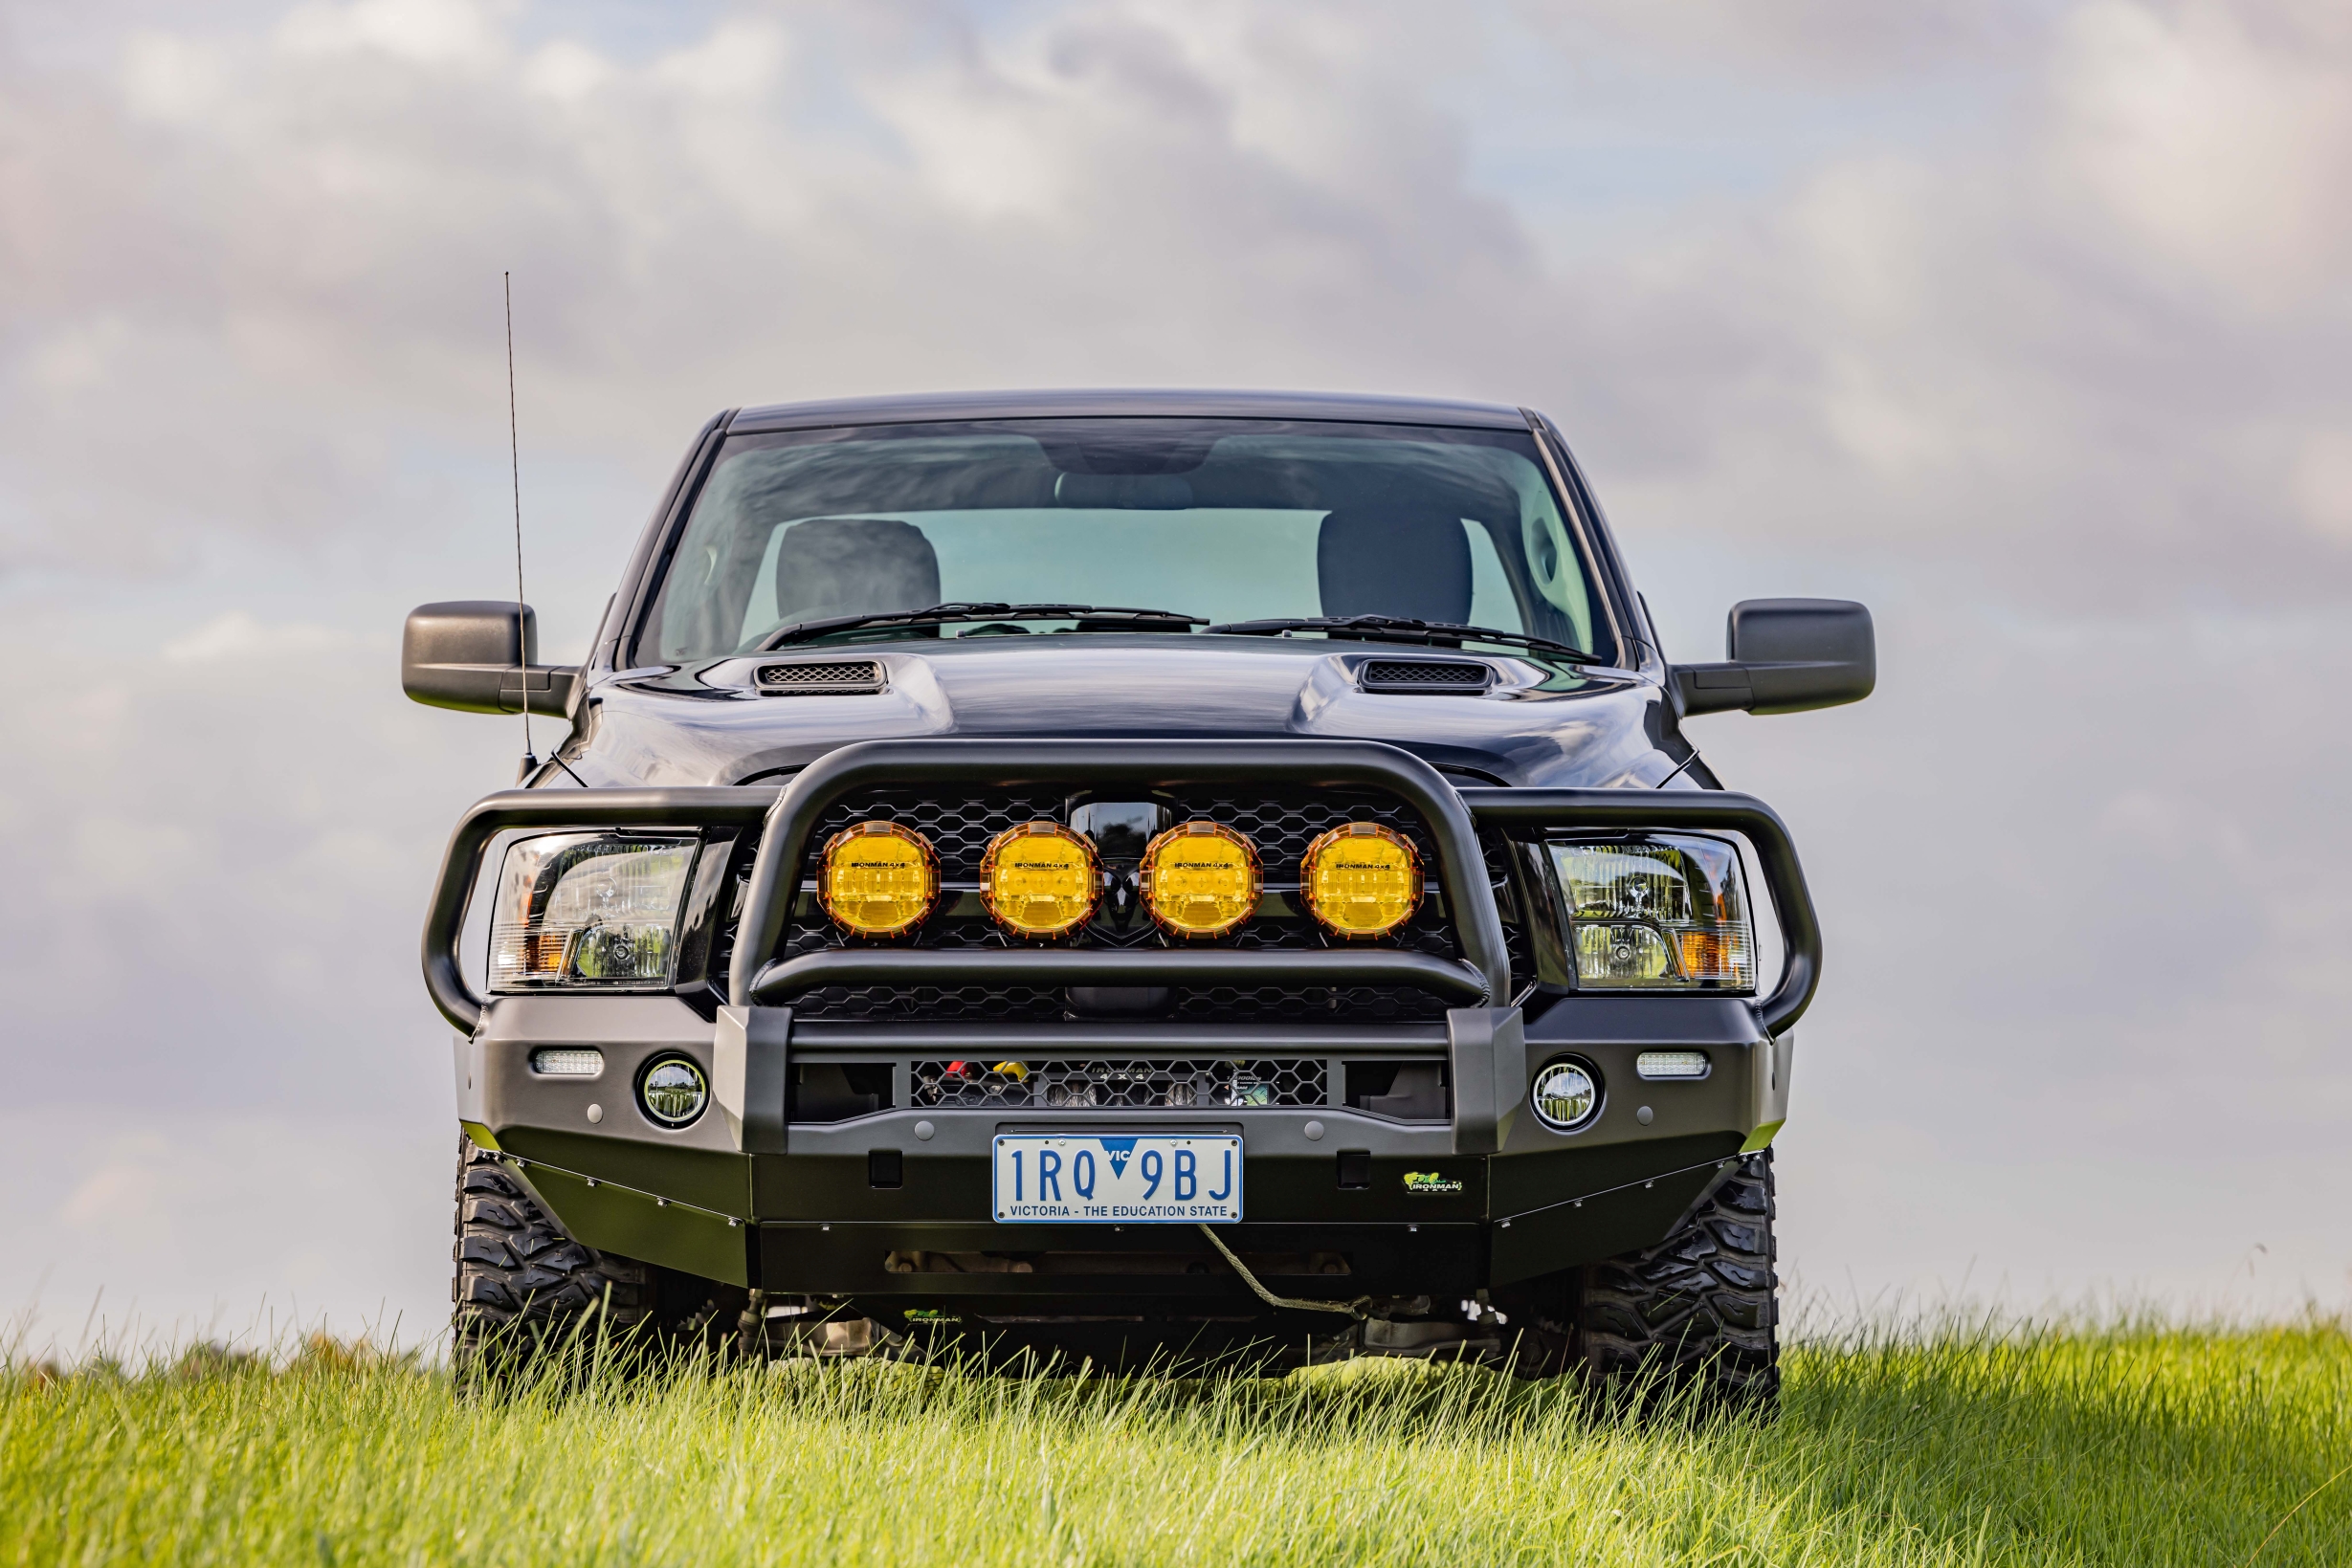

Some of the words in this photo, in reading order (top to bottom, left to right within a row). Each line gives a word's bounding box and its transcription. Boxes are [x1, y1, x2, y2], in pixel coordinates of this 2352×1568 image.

[1105, 1150, 1131, 1161] VIC
[1010, 1149, 1096, 1202] 1RQ
[1141, 1149, 1231, 1202] 9BJ
[1010, 1205, 1070, 1217] VICTORIA
[1083, 1205, 1108, 1217] THE
[1112, 1205, 1186, 1217] EDUCATION
[1189, 1205, 1228, 1217] STATE
